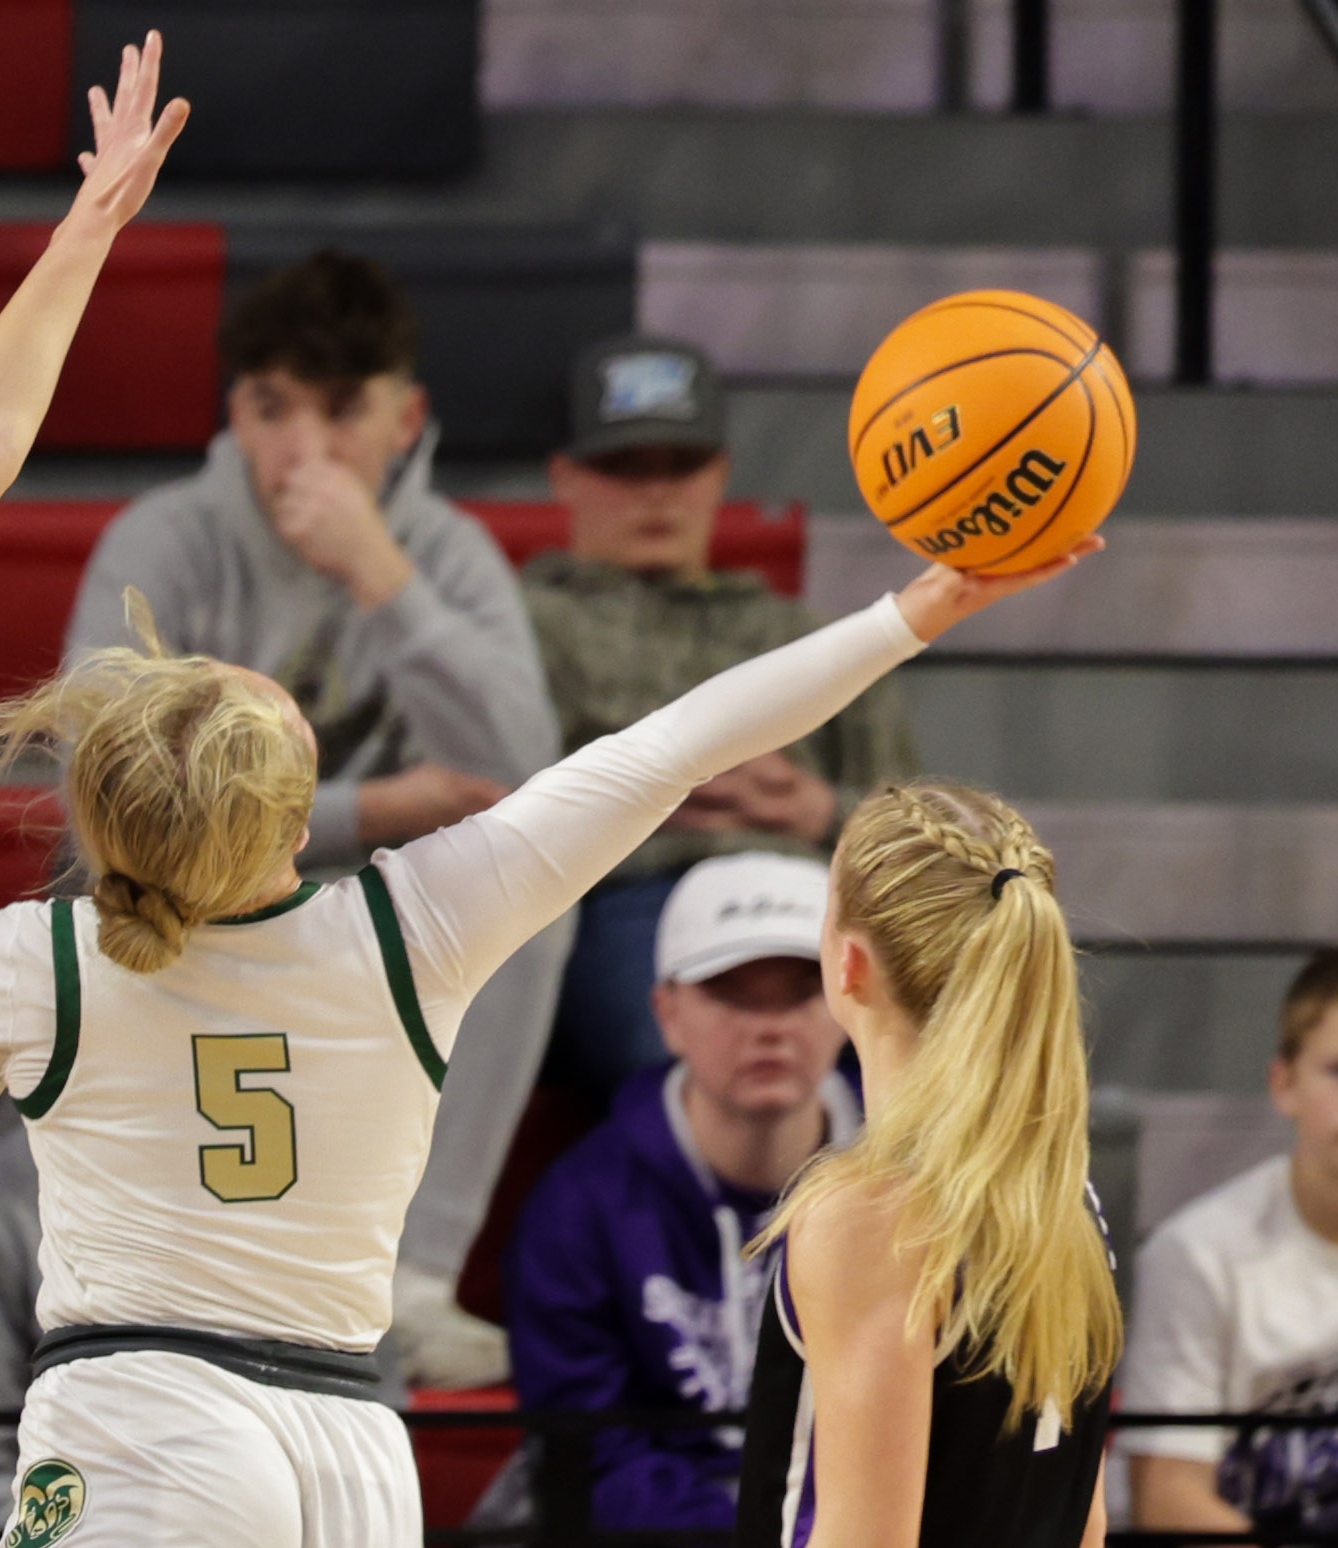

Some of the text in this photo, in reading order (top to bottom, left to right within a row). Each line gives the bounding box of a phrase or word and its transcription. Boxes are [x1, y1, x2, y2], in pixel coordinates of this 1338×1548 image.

[881, 403, 960, 487] EVO
[914, 448, 1066, 556] Wilson
[191, 1033, 298, 1203] 5
